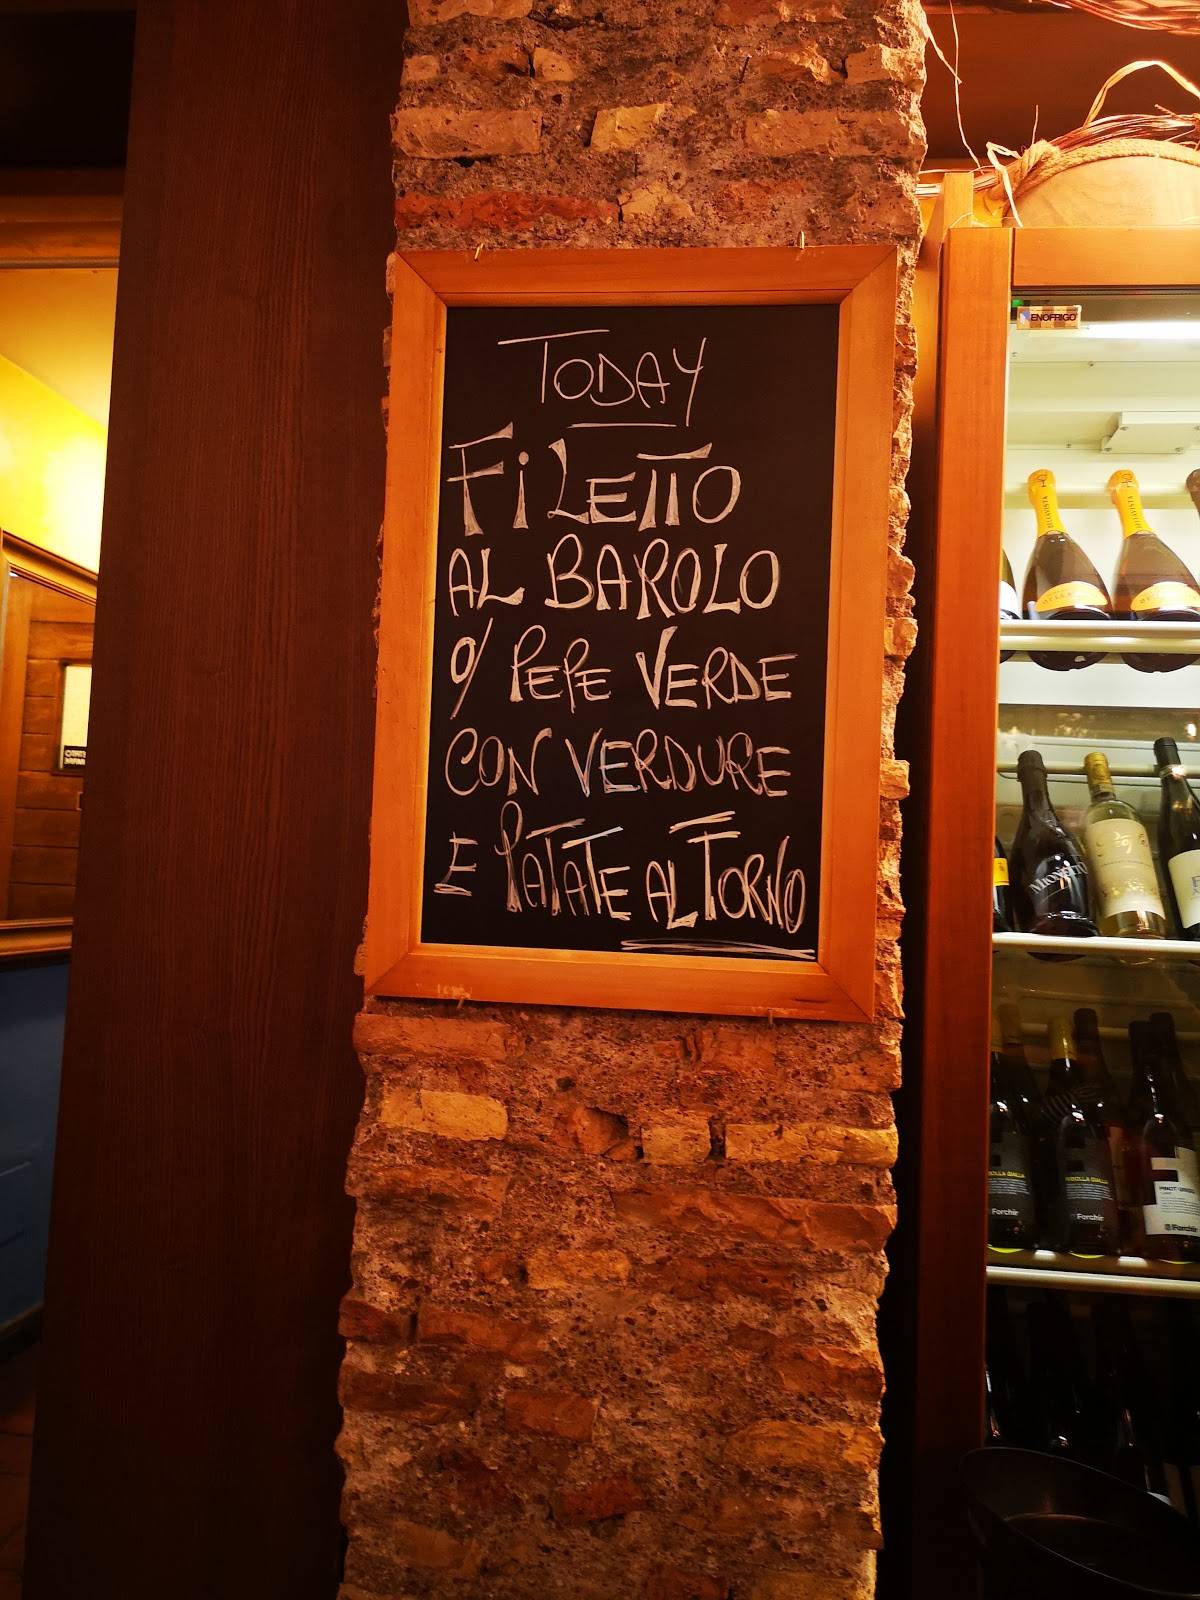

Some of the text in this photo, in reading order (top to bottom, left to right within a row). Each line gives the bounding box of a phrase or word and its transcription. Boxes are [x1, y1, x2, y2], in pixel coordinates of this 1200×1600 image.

[1030, 313, 1077, 322] ENOFRIGO
[497, 329, 707, 427] TODAY
[448, 533, 780, 620] AL BAROLO
[509, 624, 612, 714] PEPE
[635, 626, 799, 710] VERDE
[444, 727, 792, 798] CON VERDURE
[433, 831, 479, 897] E
[494, 800, 632, 921] PATATE
[645, 860, 699, 930] AL
